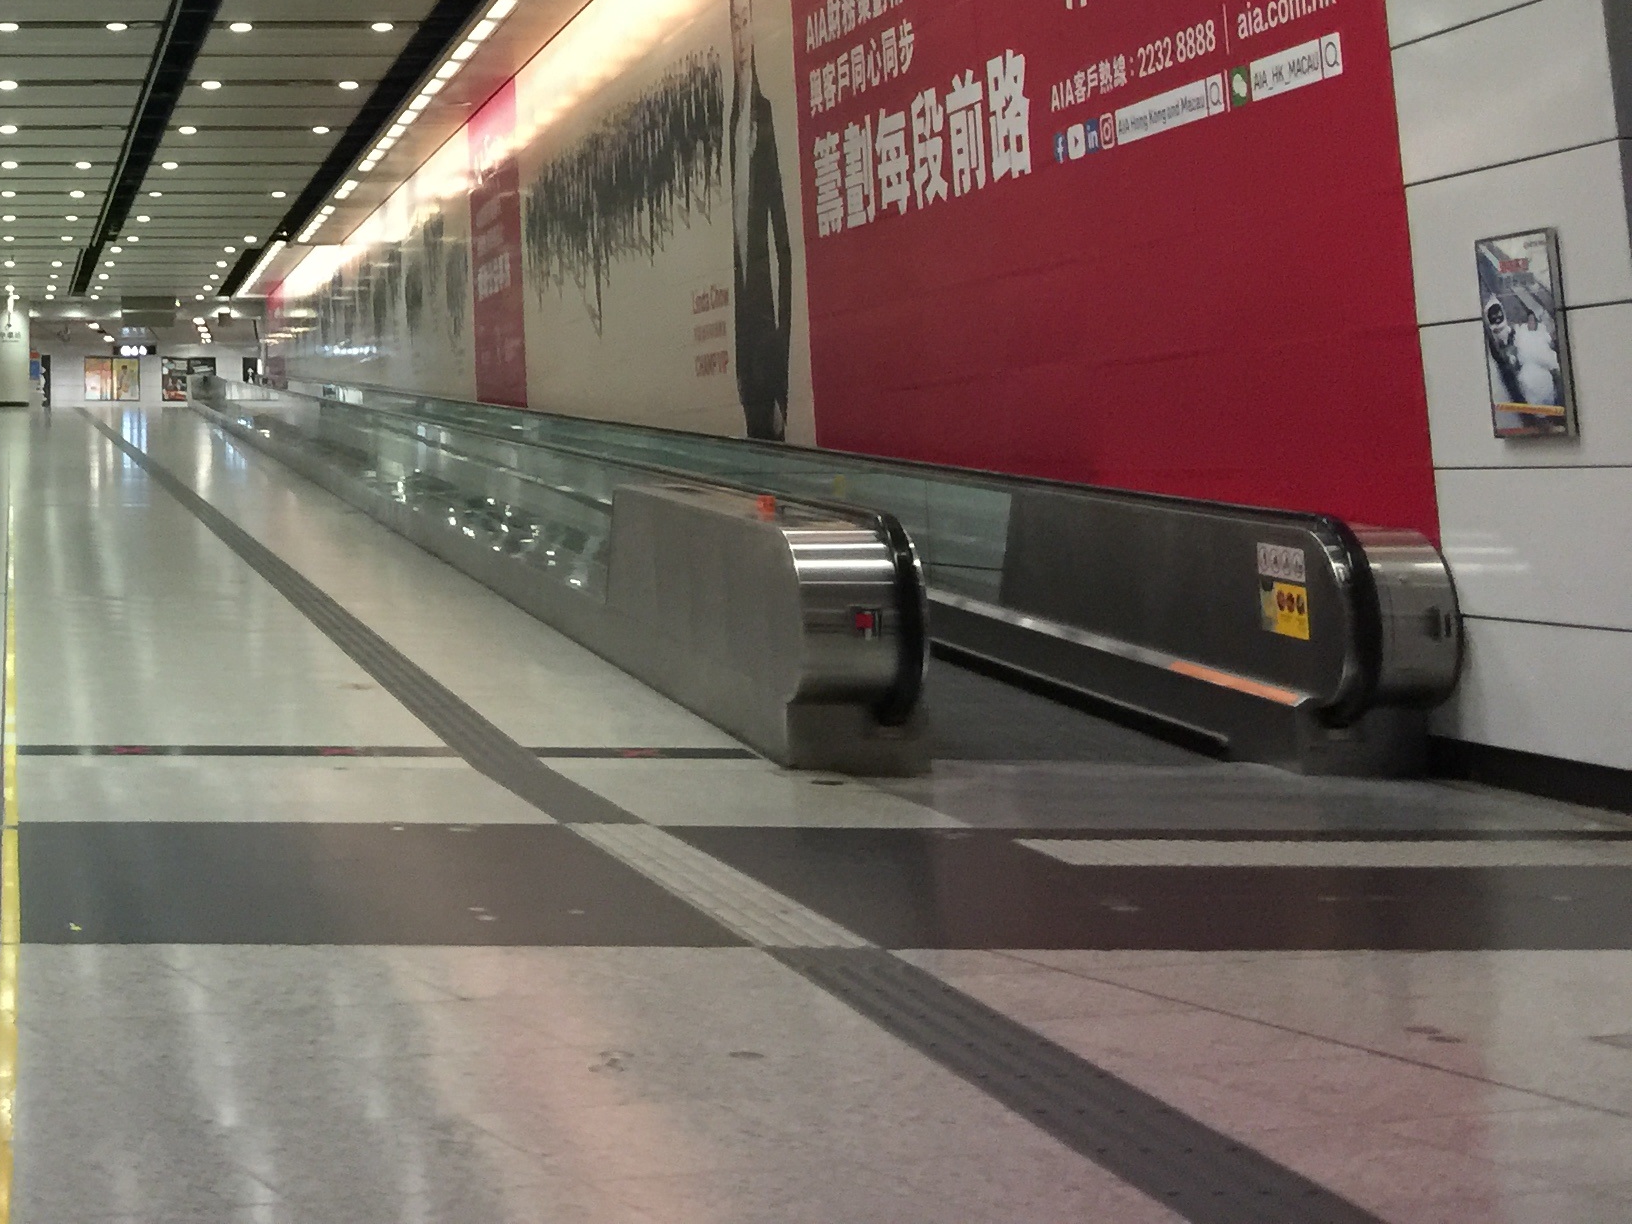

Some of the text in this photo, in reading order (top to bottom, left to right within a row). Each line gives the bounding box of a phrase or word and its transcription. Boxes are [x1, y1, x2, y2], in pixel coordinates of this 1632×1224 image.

[809, 18, 915, 117] 與客戶同心同步
[1137, 36, 1173, 78] 2232
[1176, 19, 1216, 63] 8888
[813, 49, 1032, 238] 籌劃每段前路
